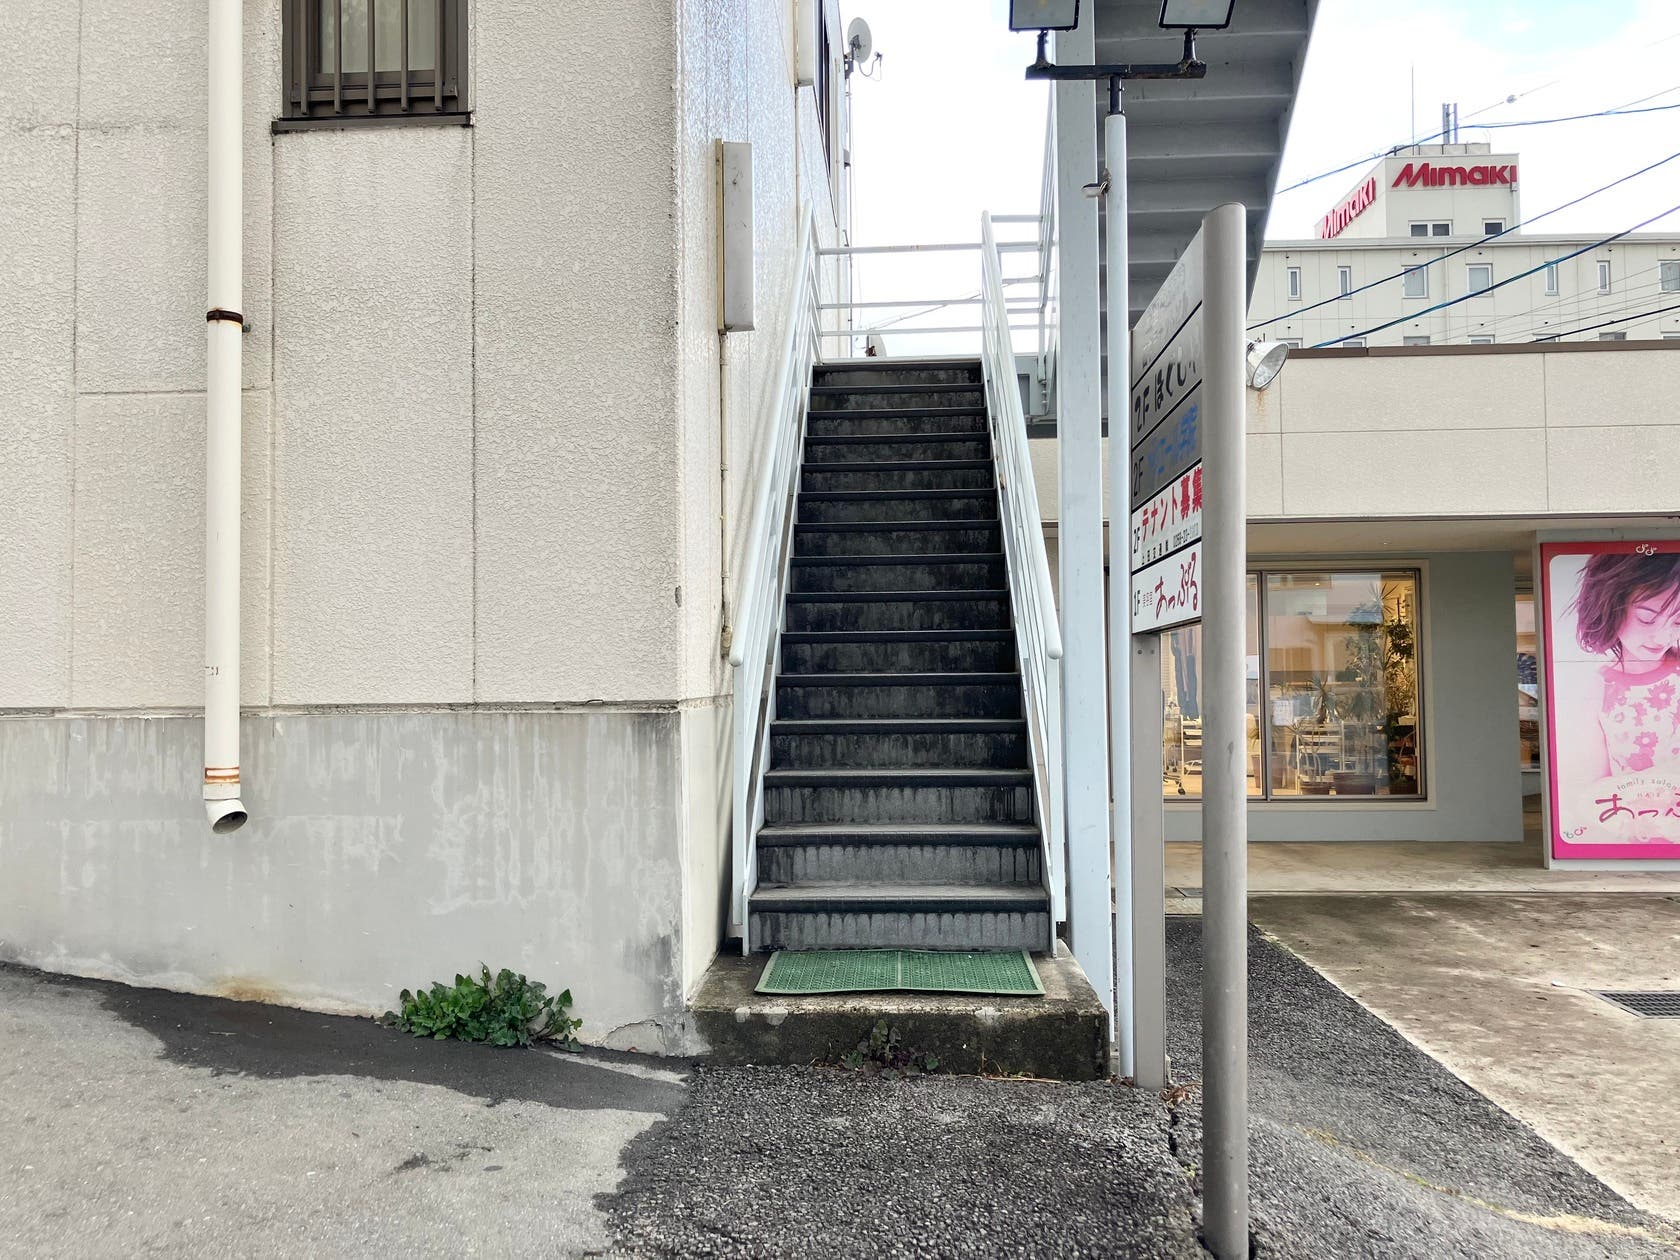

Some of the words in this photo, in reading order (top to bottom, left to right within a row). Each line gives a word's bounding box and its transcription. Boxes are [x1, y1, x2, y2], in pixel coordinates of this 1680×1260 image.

[1391, 162, 1518, 188] Mimaki
[1134, 384, 1150, 433] 2F
[1133, 455, 1144, 498] 2F
[1133, 525, 1141, 554] 2F
[1142, 466, 1203, 542] テナント募集
[1133, 589, 1141, 617] 1F
[1154, 551, 1198, 621] あっぷる
